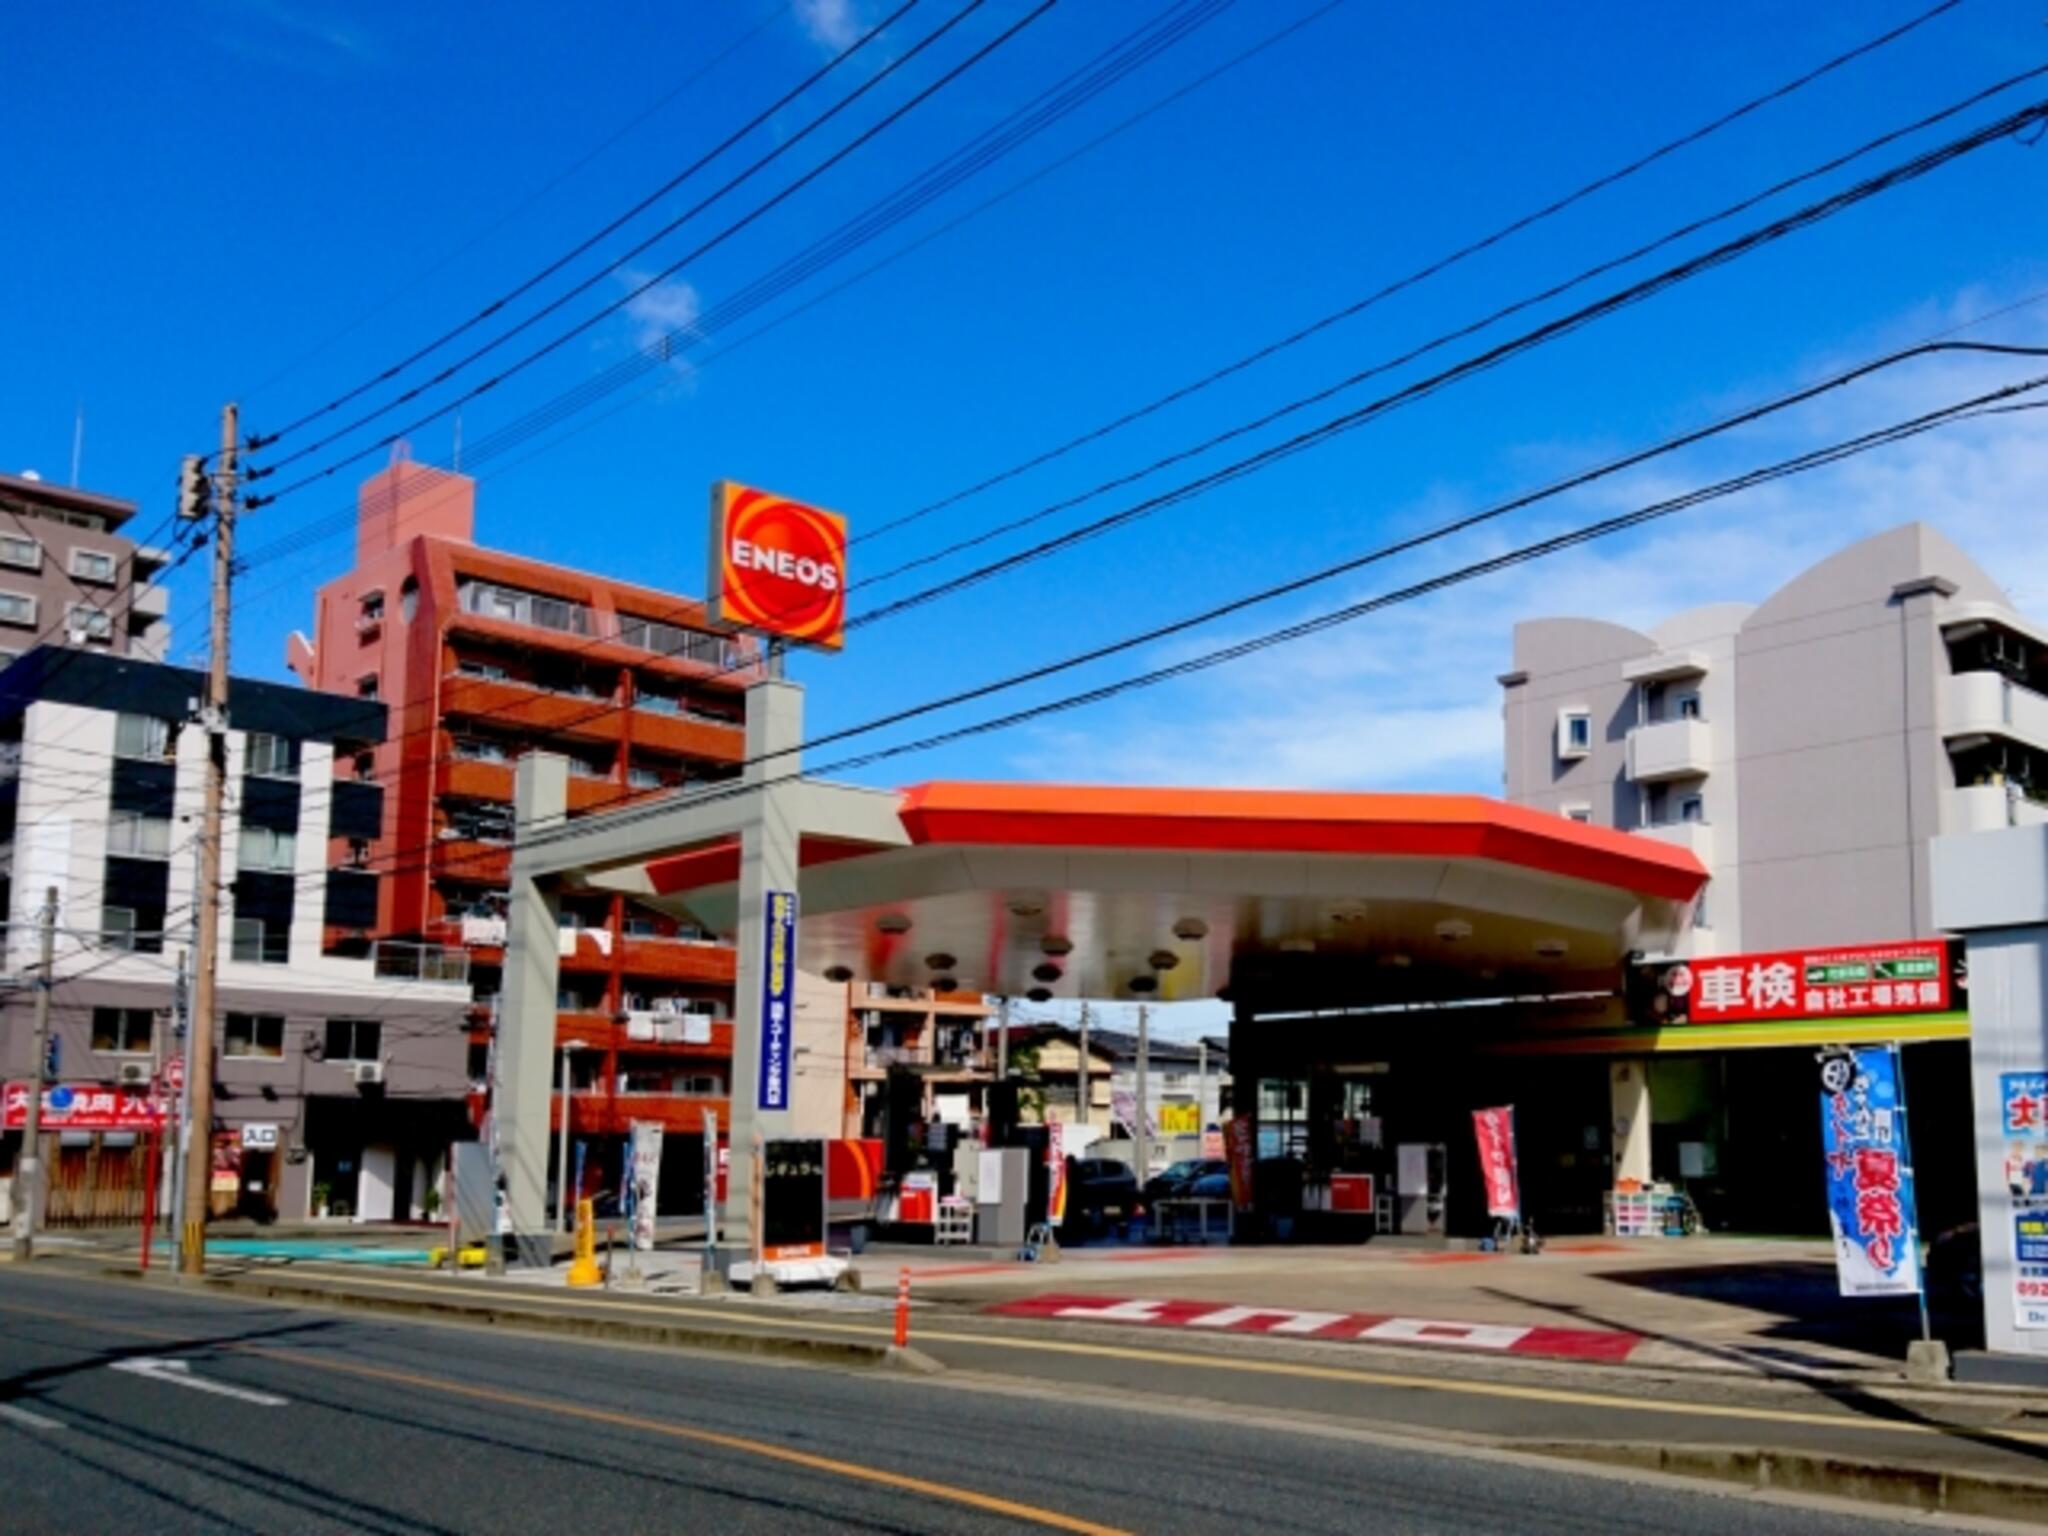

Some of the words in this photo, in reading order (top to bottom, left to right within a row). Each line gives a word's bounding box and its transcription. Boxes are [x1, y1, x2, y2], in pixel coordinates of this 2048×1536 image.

[731, 537, 839, 591] ENEOS
[1697, 960, 1797, 1012] 車検
[1804, 981, 1941, 1012] 自社工場完備
[245, 1128, 277, 1143] 入口
[1854, 1147, 1902, 1271] 夏祭り
